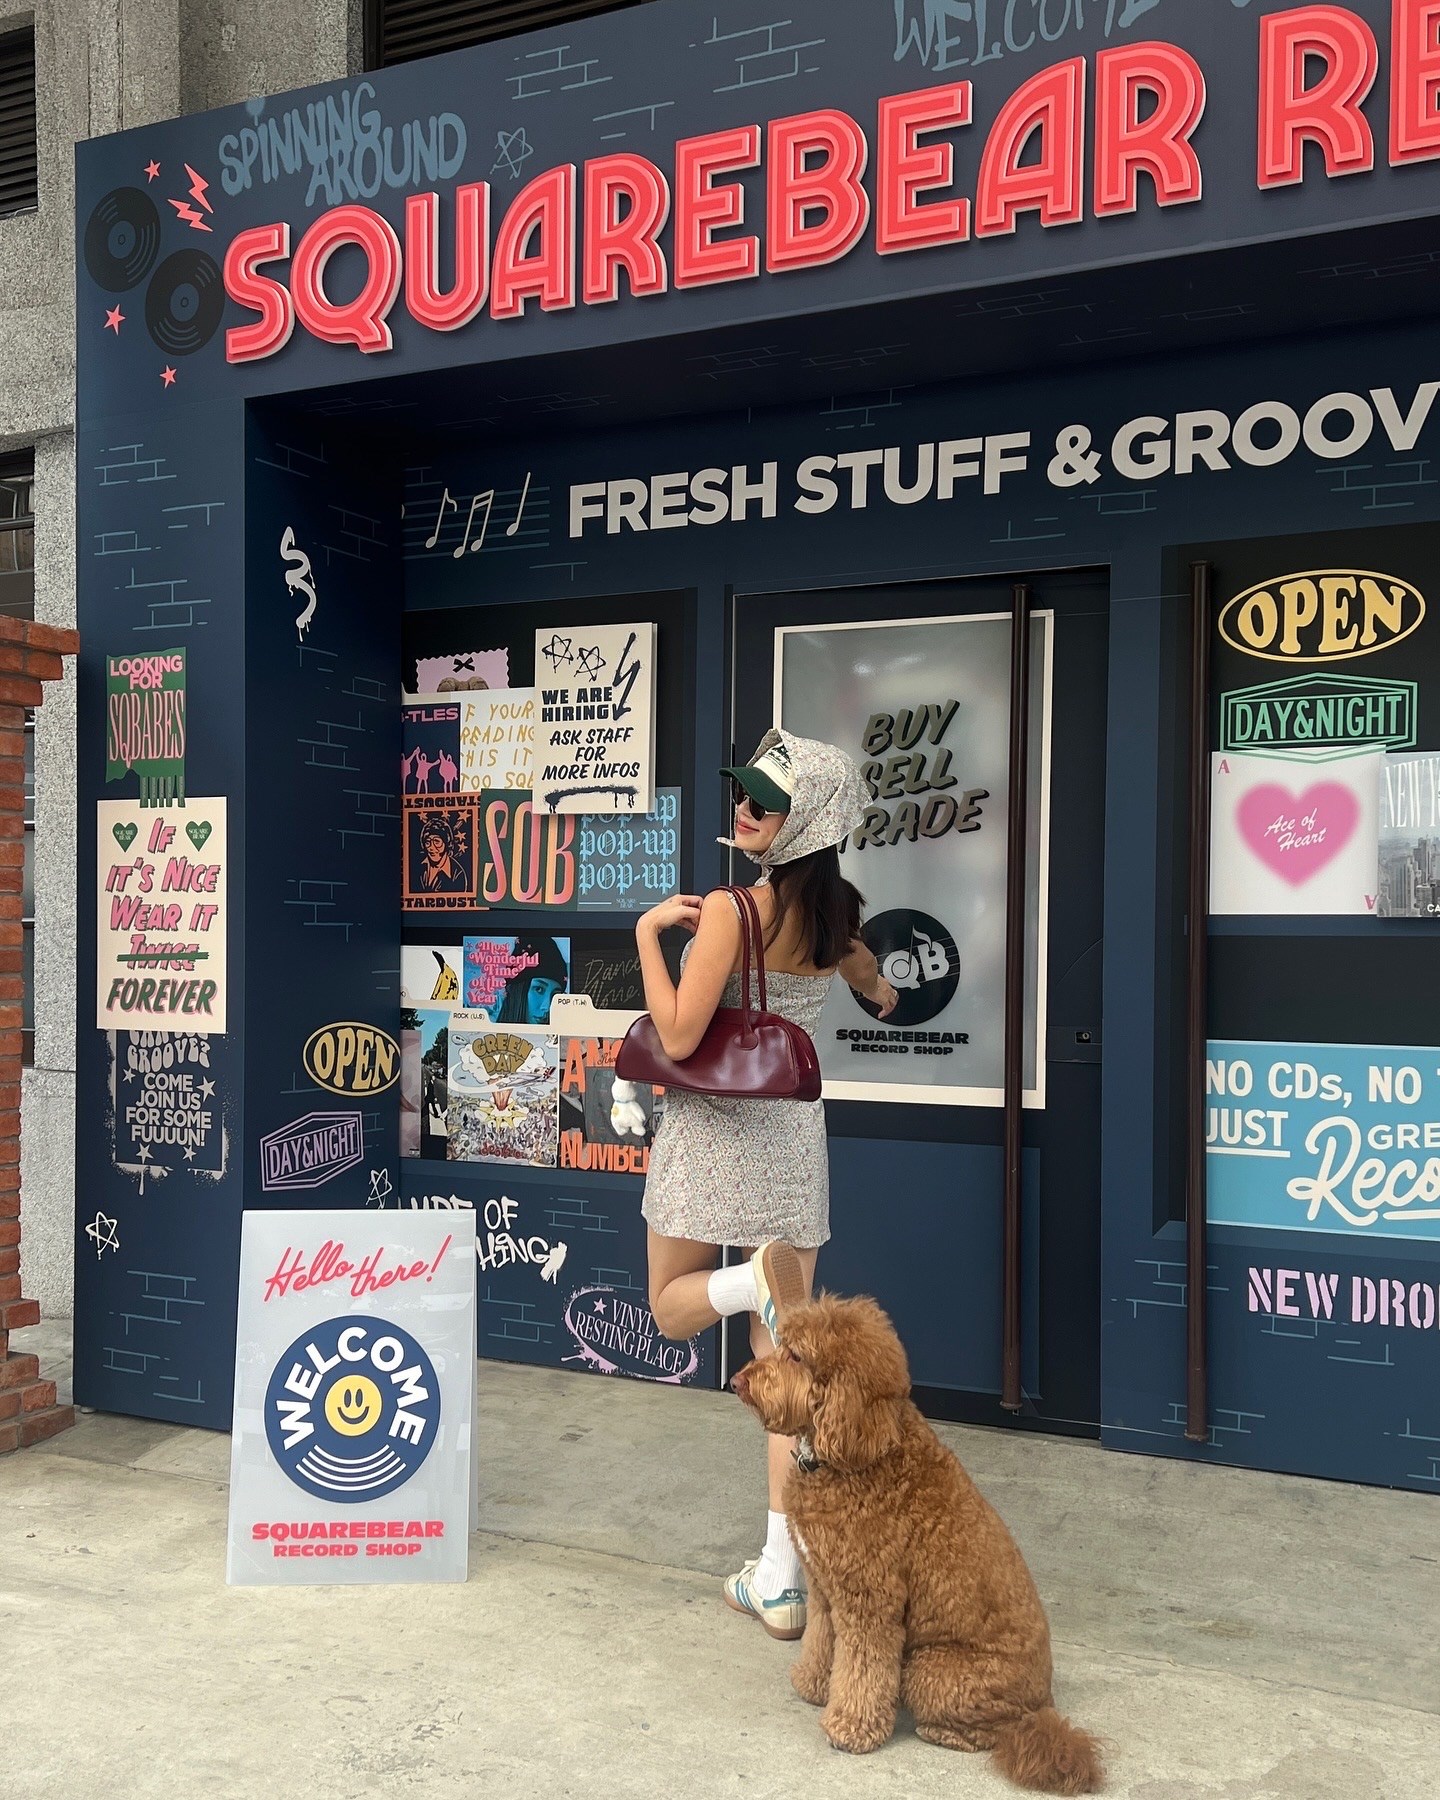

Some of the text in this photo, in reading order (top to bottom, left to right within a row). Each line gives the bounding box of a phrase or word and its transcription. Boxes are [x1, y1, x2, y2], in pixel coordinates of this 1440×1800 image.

[218, 82, 383, 196] SPINNING
[305, 112, 467, 207] AROUND
[222, 40, 1207, 365] SQUAREBEAR
[569, 381, 1440, 538] FRESH STUFF & GROOV
[1236, 576, 1406, 654] OPEN
[110, 655, 183, 676] LOOKING
[130, 672, 163, 690] FOR
[541, 686, 613, 705] WE ARE
[402, 707, 459, 723] -TLES
[541, 703, 609, 722] HIRING
[1235, 695, 1402, 741] DAY&NIGHT
[109, 690, 185, 769] SQBABES
[550, 727, 634, 746] ASK STAFF
[861, 699, 960, 756] BUY
[460, 748, 498, 768] HIS
[575, 746, 606, 762] FOR
[1217, 759, 1230, 775] A
[461, 773, 491, 791] TOO
[542, 762, 640, 780] MORE INFOS
[860, 747, 958, 801] SELL
[1384, 757, 1440, 828] NEW Y
[147, 816, 177, 854] IF
[835, 788, 990, 854] RADE
[1264, 807, 1319, 837] Ace of
[482, 800, 576, 905] SQB
[1278, 827, 1328, 853] Heart
[105, 856, 221, 893] IT'S NICE
[110, 895, 219, 932] WEAR IT
[468, 952, 539, 972] Wonderful
[476, 941, 510, 954] Most
[470, 975, 507, 992] of the
[482, 963, 519, 978] Time
[106, 977, 219, 1016] FOREVER
[467, 990, 498, 1004] Year
[557, 998, 571, 1006] POP
[472, 1033, 534, 1061] GREEN
[836, 1029, 969, 1045] SQUAREBEAR
[851, 1043, 954, 1056] RECORD SHOP
[127, 1037, 211, 1074] GROOVE?
[313, 1027, 396, 1091] OPEN
[481, 1053, 526, 1076] DAY
[144, 1072, 194, 1093] COME
[1206, 1059, 1422, 1108] NO CDs, NO
[135, 1090, 201, 1111] JOIN US
[125, 1106, 212, 1130] FOR SOME
[1206, 1107, 1289, 1147] JUST
[131, 1124, 206, 1147] FUUUUN!
[269, 1122, 356, 1179] DAY&NIGHT
[484, 1195, 519, 1230] OF
[263, 1234, 453, 1303] Hello there!
[1248, 1267, 1440, 1330] NEW DRO
[612, 1298, 654, 1338] VINYL
[576, 1311, 685, 1375] RESTING PLACE
[276, 1326, 429, 1452] WELCOME
[252, 1520, 445, 1540] SQUAREBEAR
[273, 1542, 422, 1558] RECORD SHOP
